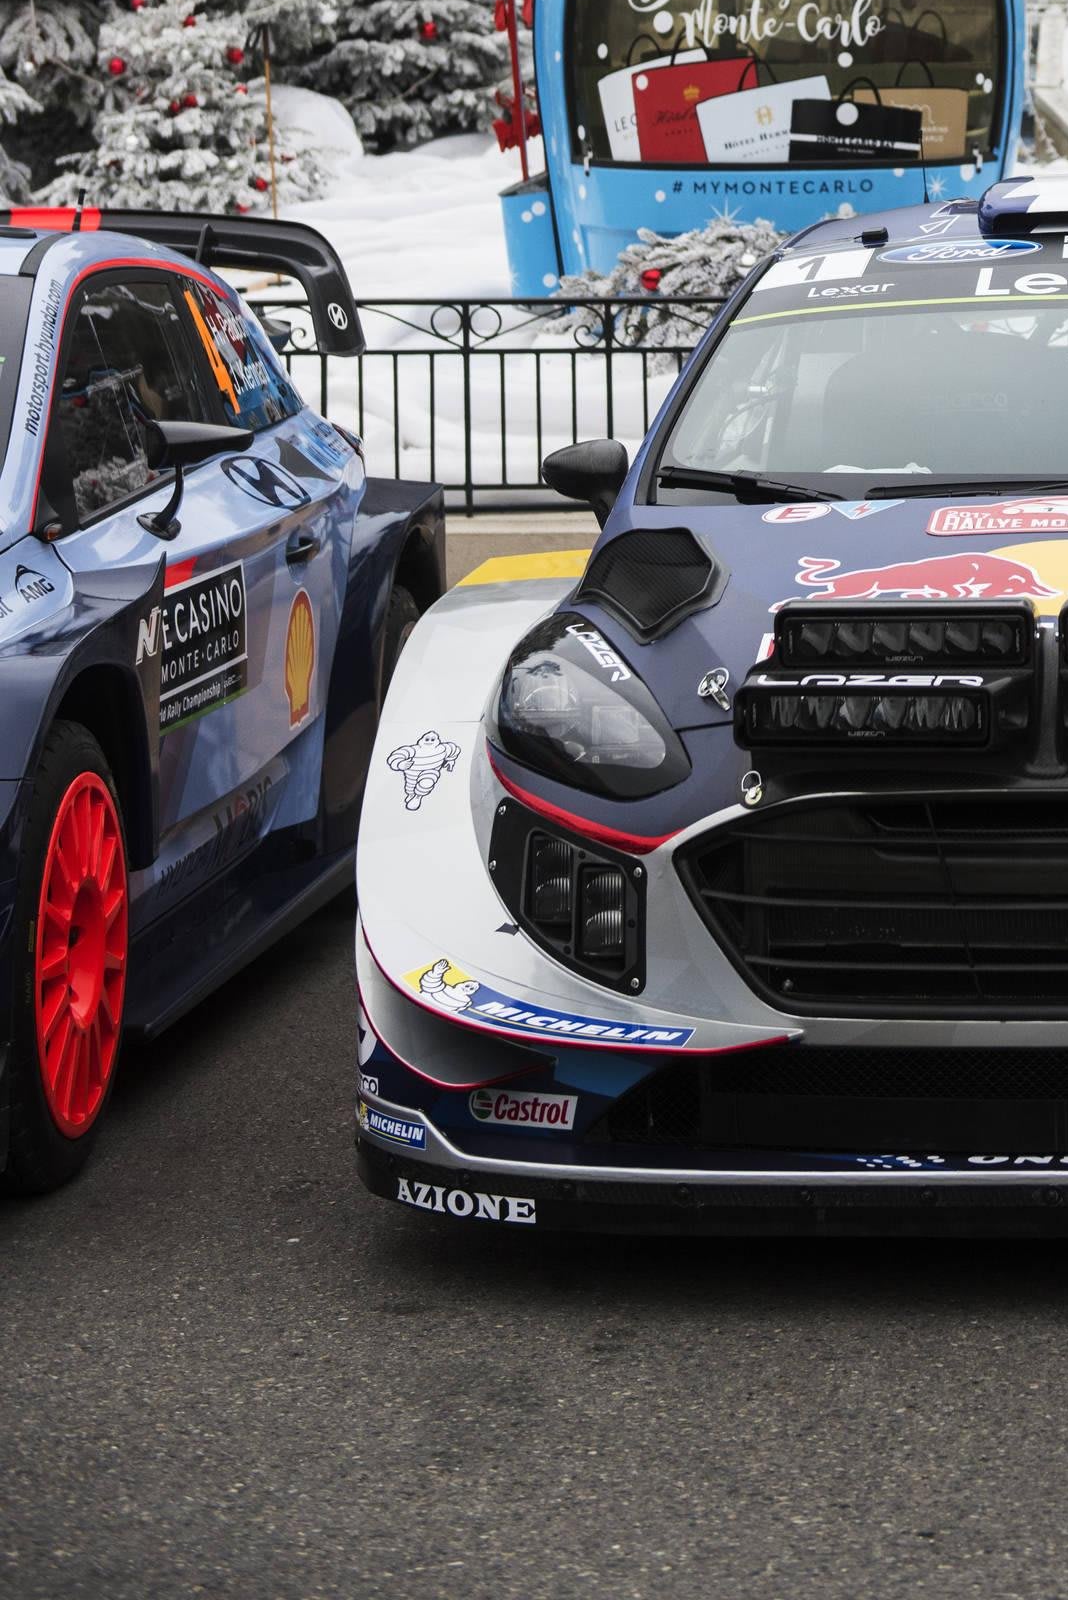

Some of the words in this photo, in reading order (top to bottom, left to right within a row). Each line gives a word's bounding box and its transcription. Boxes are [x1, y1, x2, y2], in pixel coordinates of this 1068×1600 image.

[693, 179, 874, 195] MYMONTECARLO
[906, 243, 1013, 263] Ford
[797, 255, 822, 281] 1
[807, 282, 897, 298] Lexar
[24, 277, 64, 437] motorsport.hyundai.com
[183, 289, 241, 416] 4
[784, 505, 813, 520] E
[942, 513, 1023, 531] RALLYE
[174, 578, 242, 643] CASINO
[565, 623, 631, 682] LAZER
[757, 673, 985, 687] LAZER
[476, 1001, 683, 1041] MICHELIN
[494, 1093, 569, 1125] Castrol
[369, 1114, 424, 1142] MICHELIN
[397, 1177, 537, 1224] AZIONE
